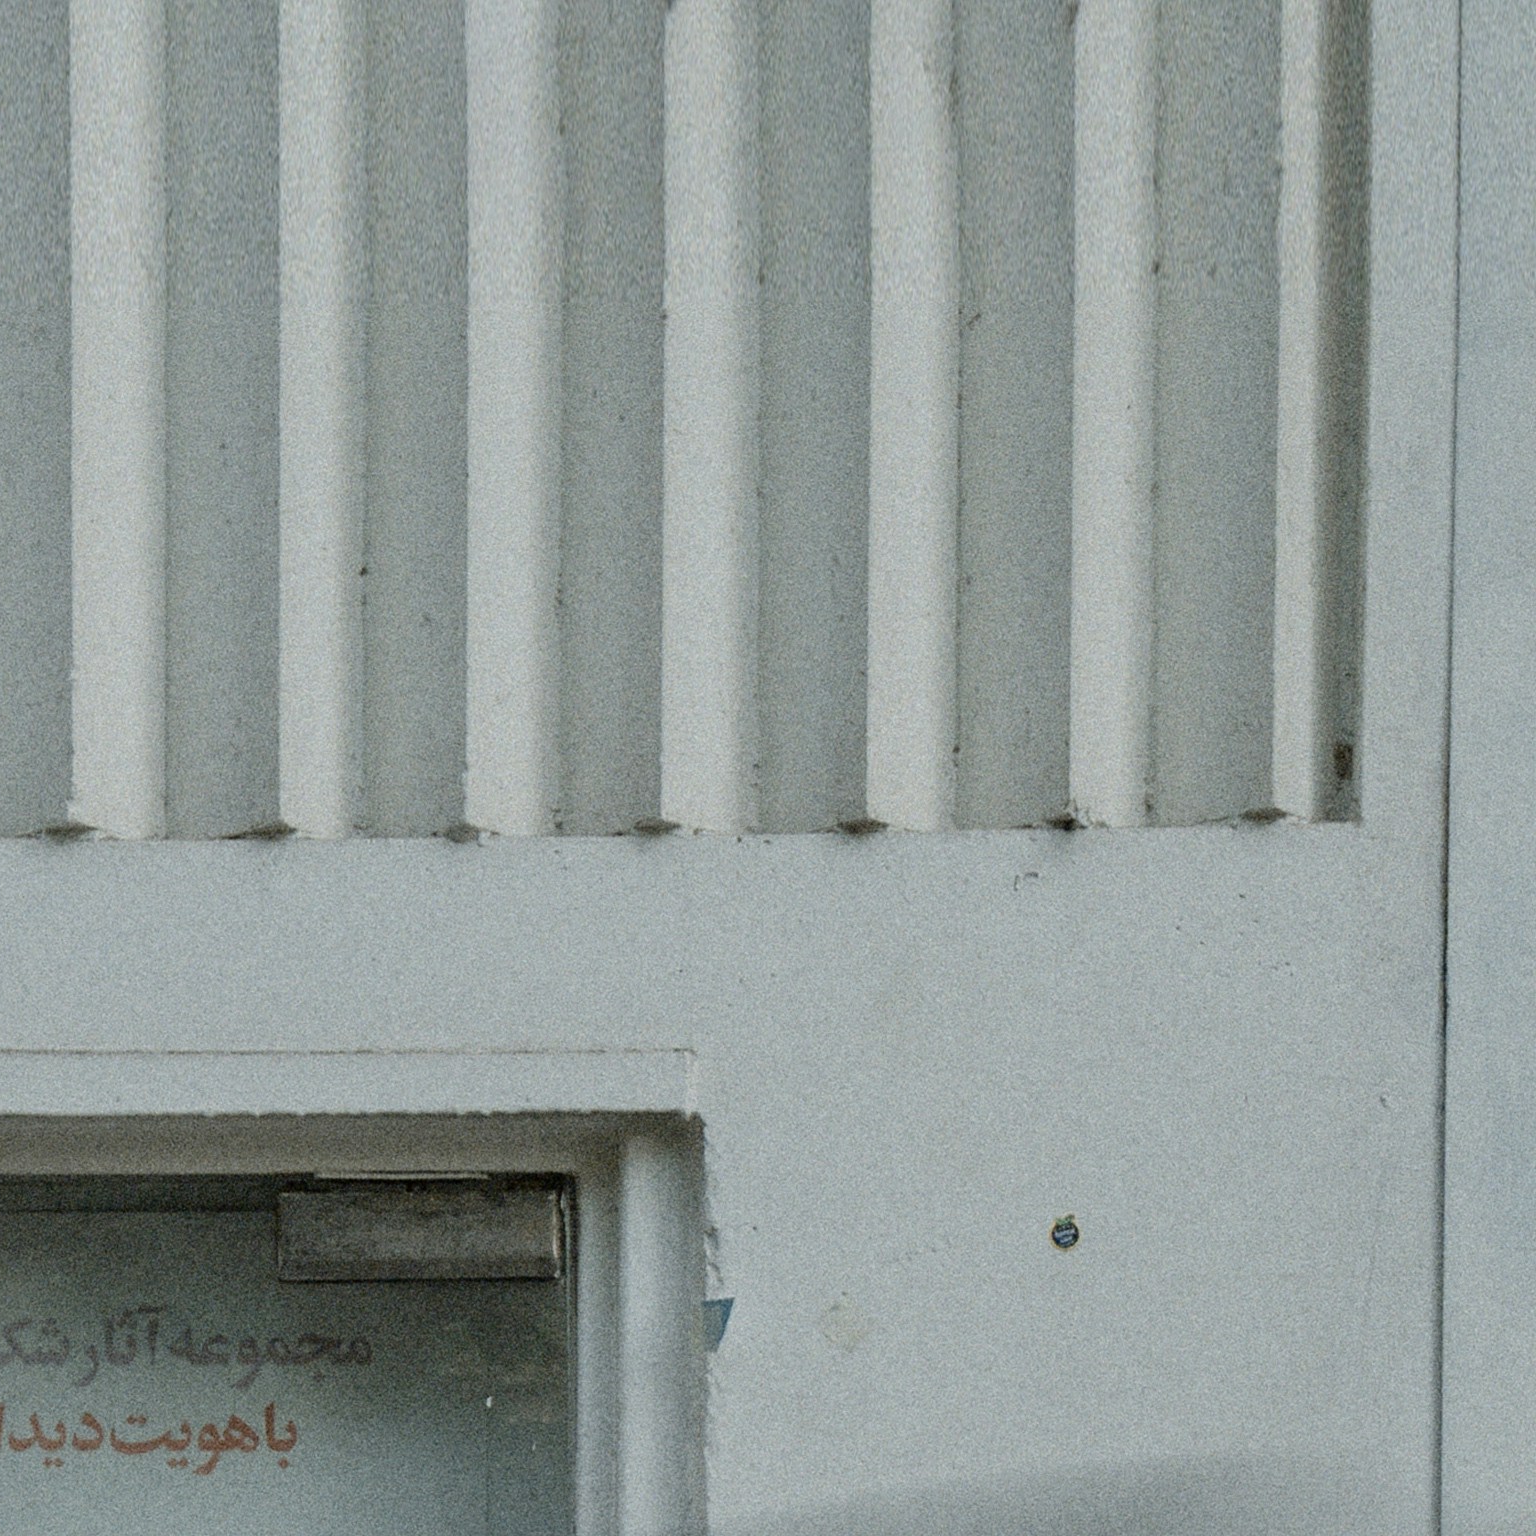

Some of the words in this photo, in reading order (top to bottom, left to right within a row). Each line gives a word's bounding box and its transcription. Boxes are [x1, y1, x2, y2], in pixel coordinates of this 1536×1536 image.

[72, 1303, 166, 1388] آثار
[167, 1325, 374, 1389] مجموعه
[109, 1412, 260, 1476] هویت
[263, 1402, 298, 1469] با
